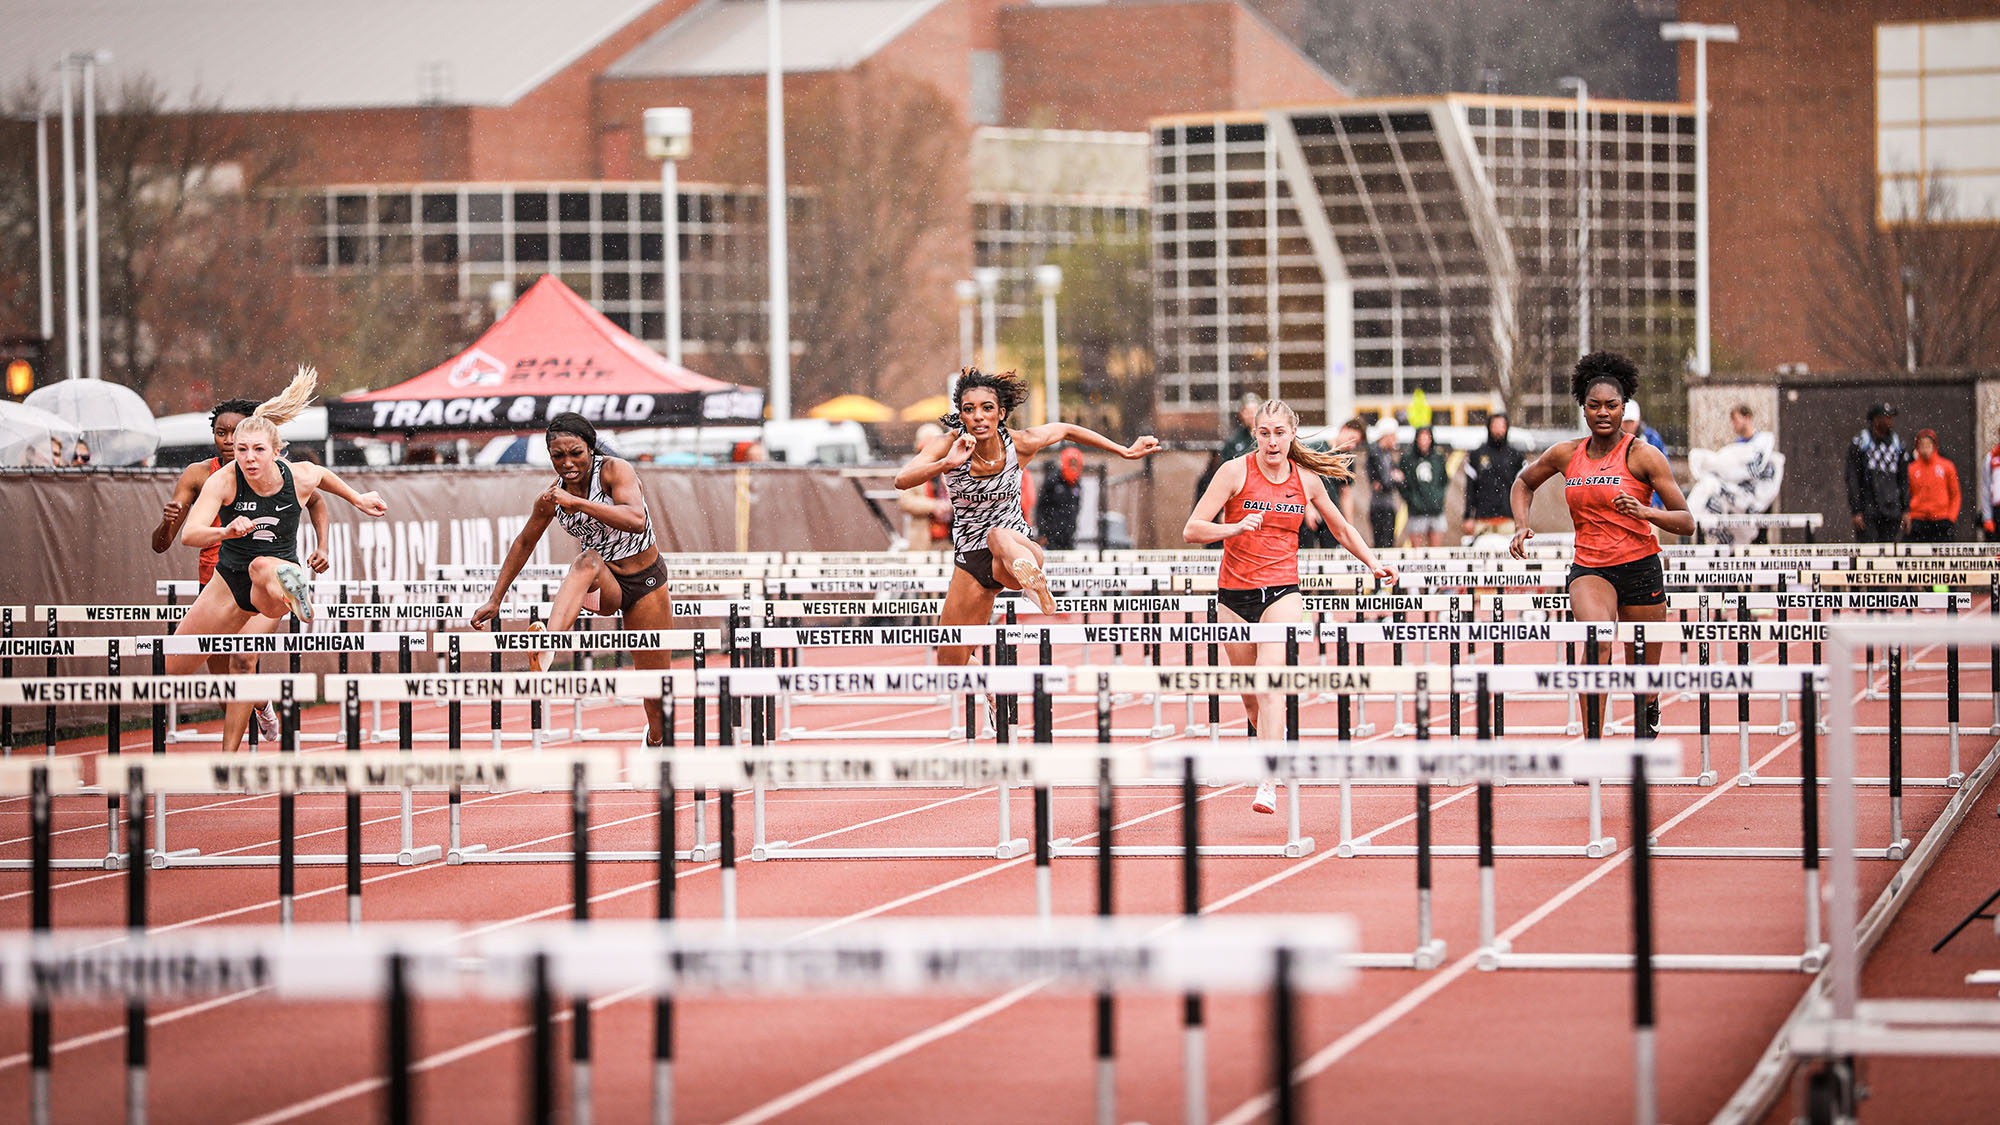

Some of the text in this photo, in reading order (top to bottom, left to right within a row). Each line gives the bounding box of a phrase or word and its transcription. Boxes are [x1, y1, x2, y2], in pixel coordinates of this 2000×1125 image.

[372, 395, 655, 427] TRACK & FIELD
[1585, 476, 1621, 485] STATE
[1244, 501, 1304, 514] BALL STATE
[1708, 561, 1811, 570] WESTERN MICHIGAN
[1896, 561, 1944, 569] WESTERN
[1072, 579, 1127, 588] MICHIGAN
[1301, 578, 1332, 587] HIGAN
[1424, 575, 1541, 586] WESTERN MICHIGAN
[1695, 573, 1752, 583] MICHIGAN
[1846, 573, 1966, 584] WESTERN MICHIGAN
[404, 584, 456, 593] WESTERN
[811, 581, 924, 590] WESTERN MICHIGAN
[1056, 598, 1179, 611] ESTERN MICHIGAN
[1301, 598, 1422, 609] STERN MICHIGAN
[1532, 597, 1570, 608] WEST
[1777, 595, 1918, 607] WESTERN MICHIGAN
[86, 608, 150, 619] WESTERN
[327, 606, 462, 618] WESTERN MICHIGAN
[803, 602, 937, 614] WESTERN MICHIGAN
[797, 629, 962, 645] WESTERN MICHIGAN
[1085, 626, 1250, 643] WESTERN MICHIGAN
[1383, 626, 1550, 641] WESTERN MICHIGAN
[1682, 625, 1828, 640] WESTERN MICHIG
[198, 636, 364, 653] WESTERN MICHIGAN
[494, 633, 660, 649] WESTERN MICHIGAN
[777, 672, 988, 690] WESTERN MICHIGAN
[1160, 672, 1370, 689] WESTERN MICHIGAN
[1536, 672, 1753, 687] WESTERN MICHIGAN
[22, 681, 235, 701] WESTERN MICHIGAN
[406, 677, 616, 696] WESTERN MICHIGAN
